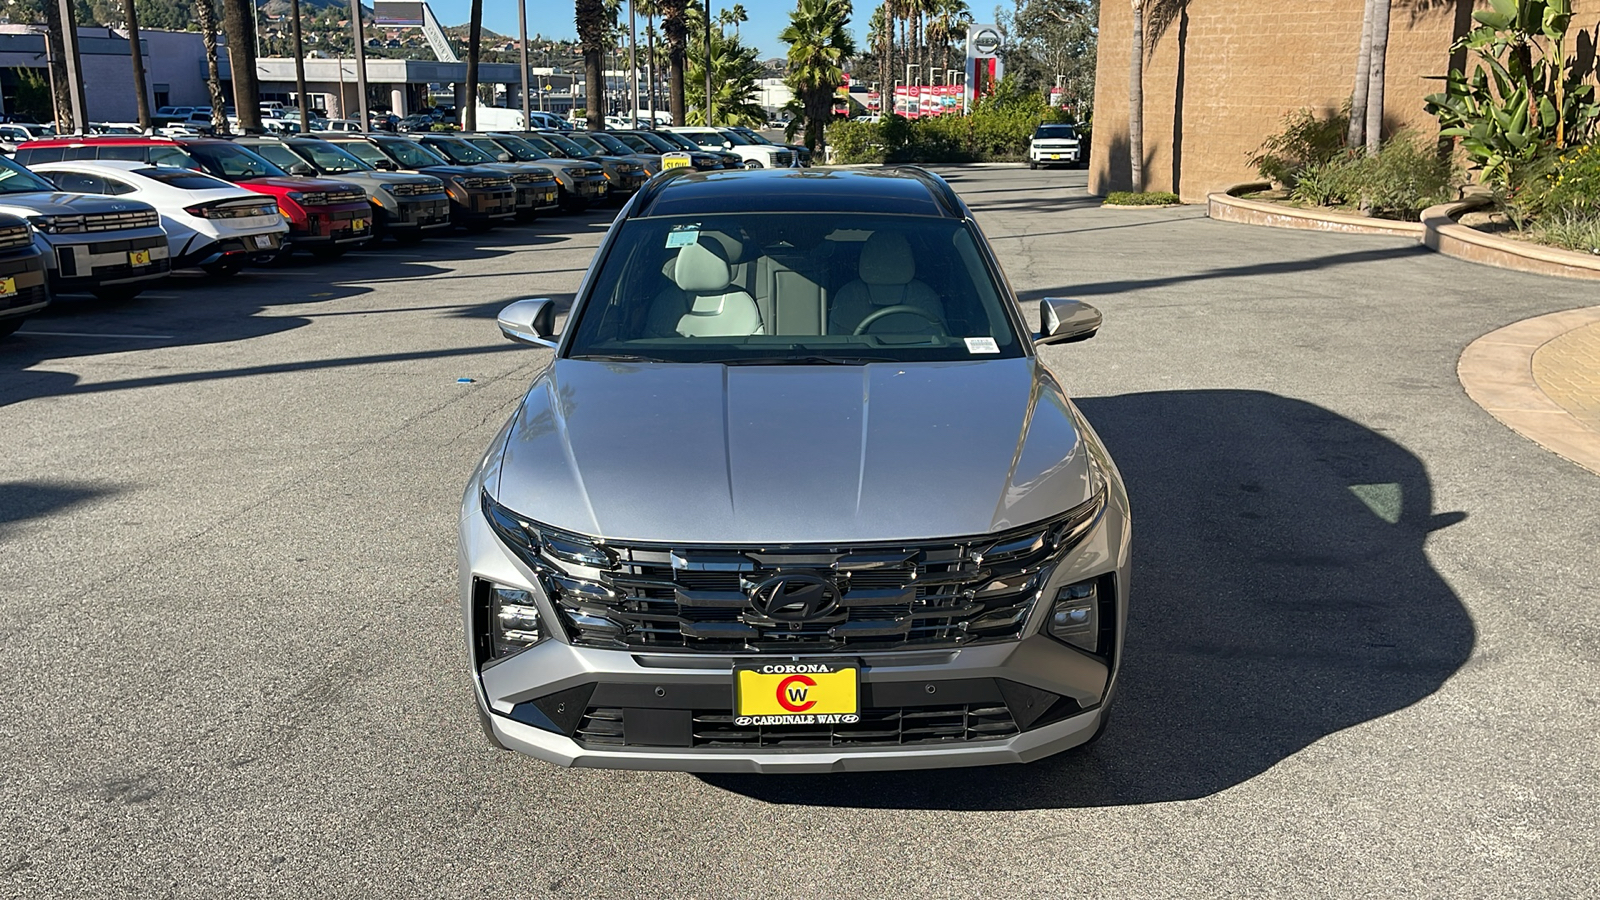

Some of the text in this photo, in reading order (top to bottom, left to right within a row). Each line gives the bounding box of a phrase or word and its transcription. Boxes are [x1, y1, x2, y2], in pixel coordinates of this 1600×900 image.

[763, 664, 829, 674] CORONA
[776, 674, 818, 712] C W
[752, 714, 842, 726] CARDINALE WAY
